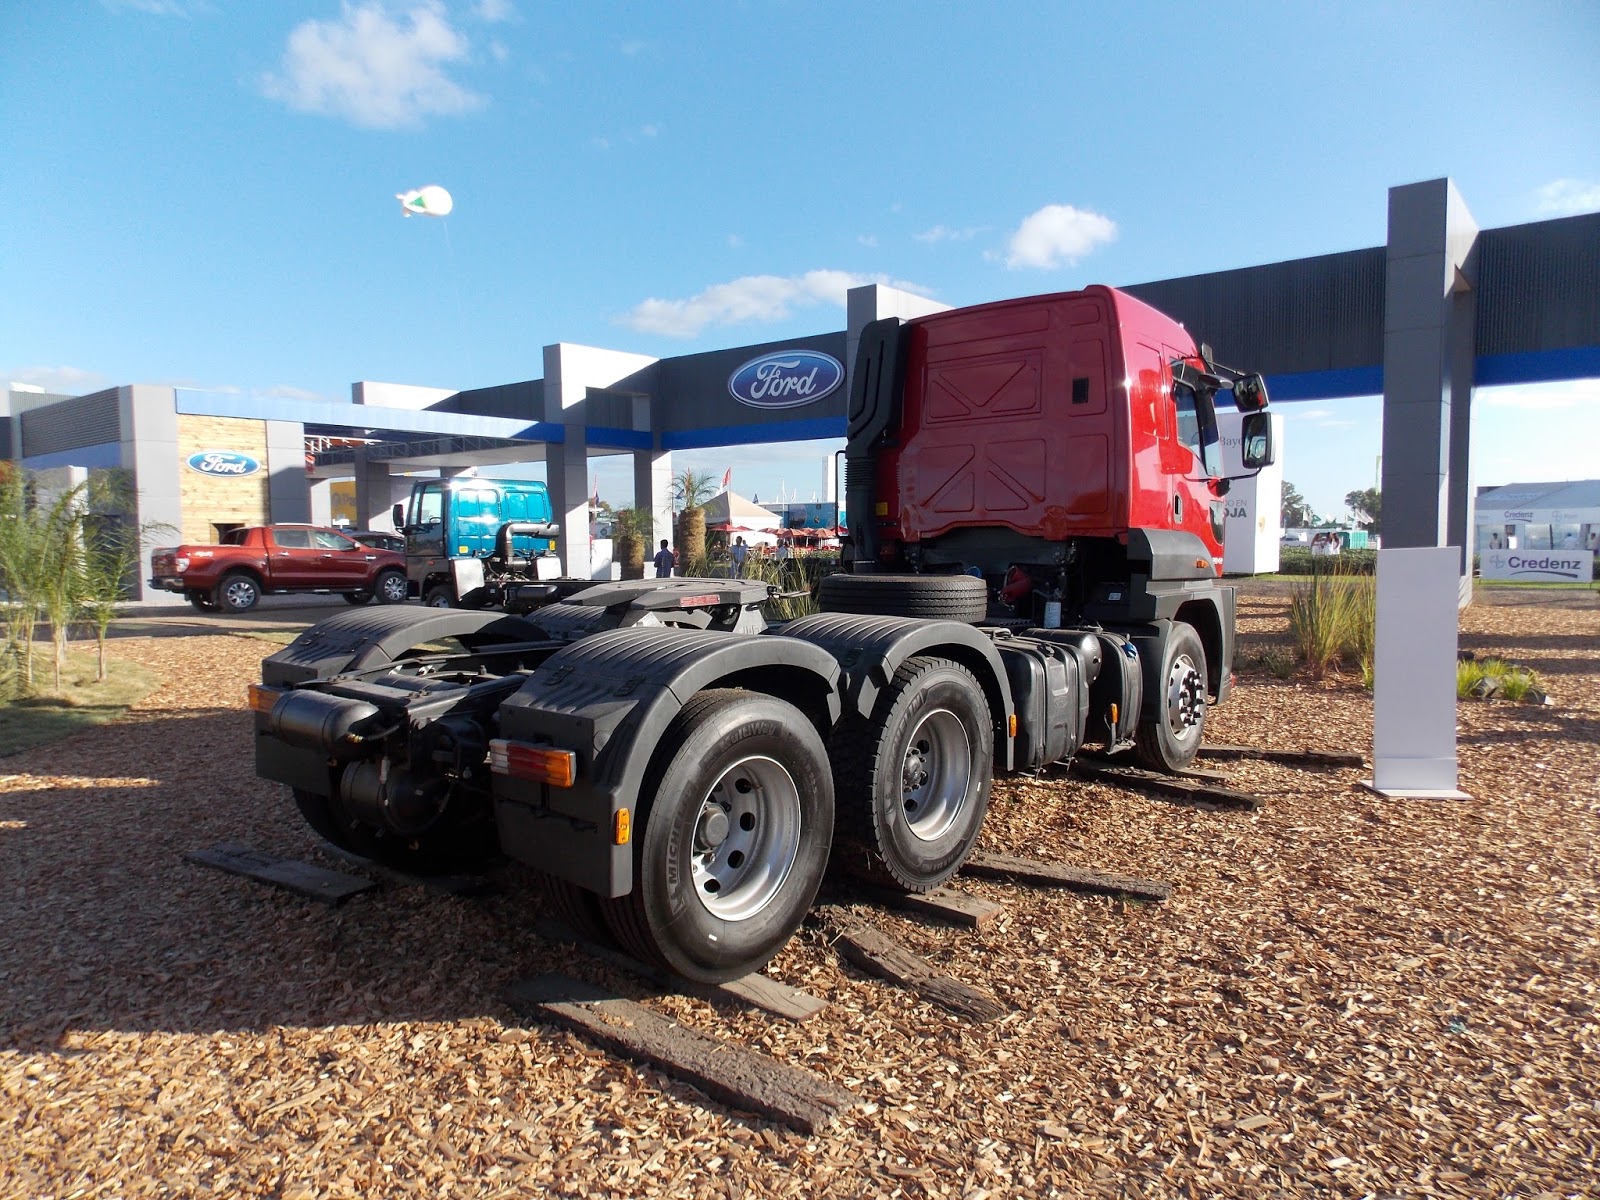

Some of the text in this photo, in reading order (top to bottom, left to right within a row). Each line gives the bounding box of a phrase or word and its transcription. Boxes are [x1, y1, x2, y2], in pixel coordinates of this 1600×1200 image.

[750, 360, 818, 399] Ford
[200, 453, 247, 474] Ford
[1508, 557, 1581, 570] Credenz
